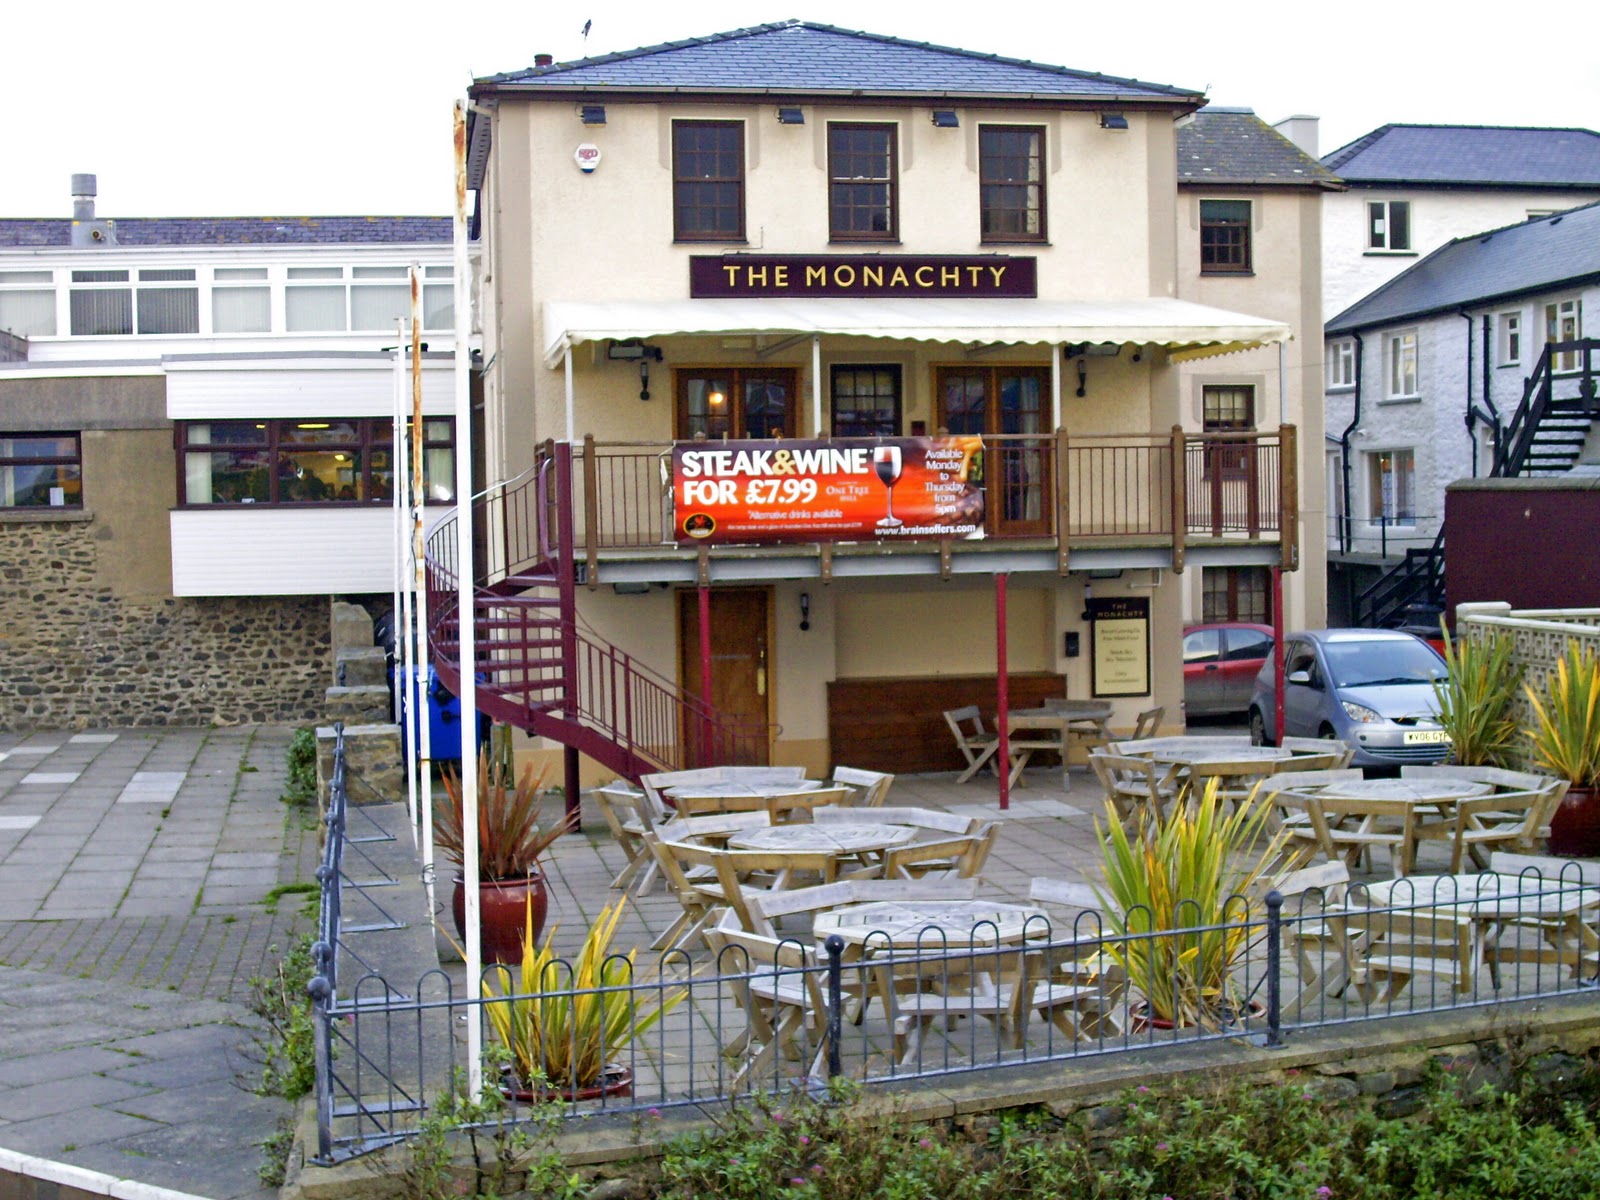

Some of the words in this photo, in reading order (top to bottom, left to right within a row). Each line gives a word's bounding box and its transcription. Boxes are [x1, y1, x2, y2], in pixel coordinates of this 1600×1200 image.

[723, 265, 789, 287] THE
[806, 264, 1007, 287] MONACHTY
[925, 449, 963, 459] Available
[926, 460, 962, 471] Monday
[940, 472, 949, 481] to
[683, 479, 739, 506] FOR
[745, 478, 818, 504] £7.99
[925, 482, 965, 494] Thursday
[935, 494, 956, 502] from
[875, 523, 976, 535] www.brainsoffers.com
